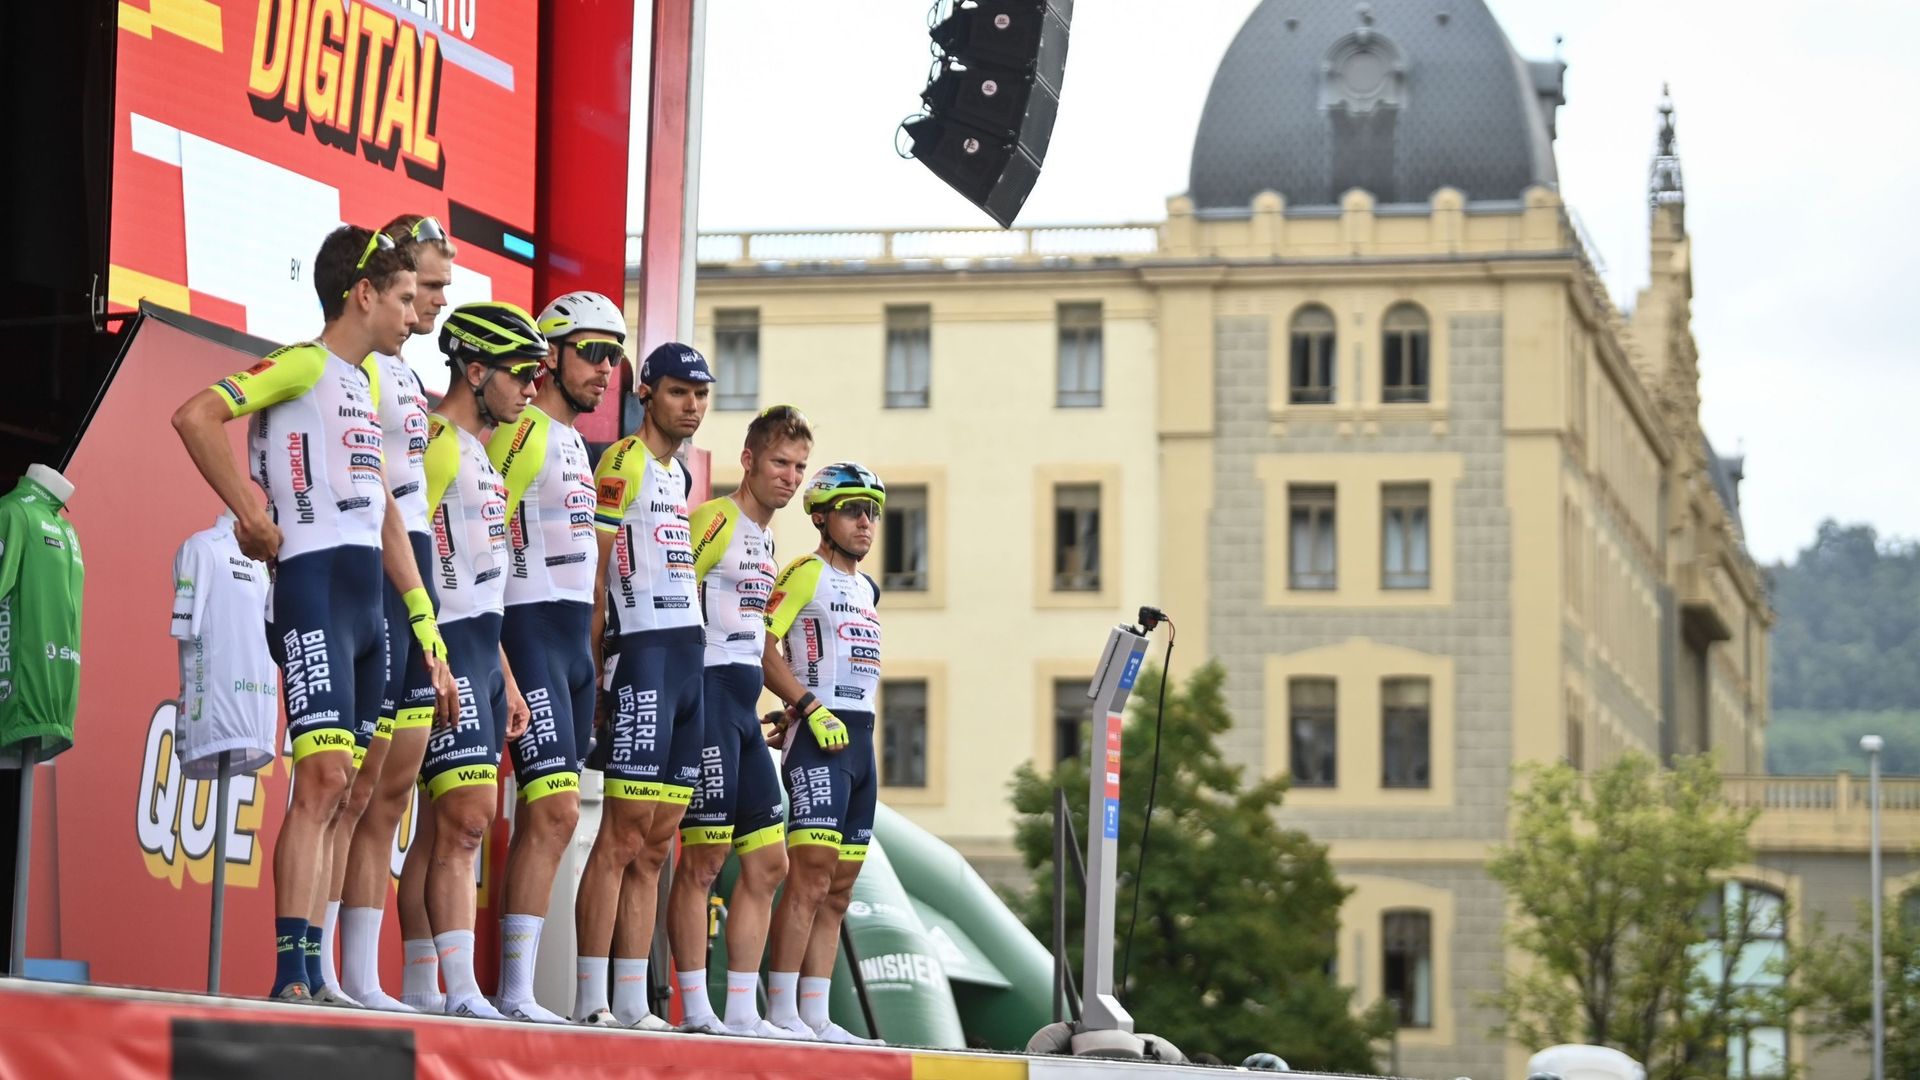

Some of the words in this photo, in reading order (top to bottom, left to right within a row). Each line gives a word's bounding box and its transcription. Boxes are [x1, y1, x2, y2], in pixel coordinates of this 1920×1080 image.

[248, 0, 443, 173] DIGITAL
[290, 257, 300, 281] BY
[301, 629, 332, 695] BIERE
[526, 688, 557, 745] BIERE
[635, 690, 658, 751] BIERE
[702, 746, 724, 800] BIERE
[807, 766, 832, 806] BIERE
